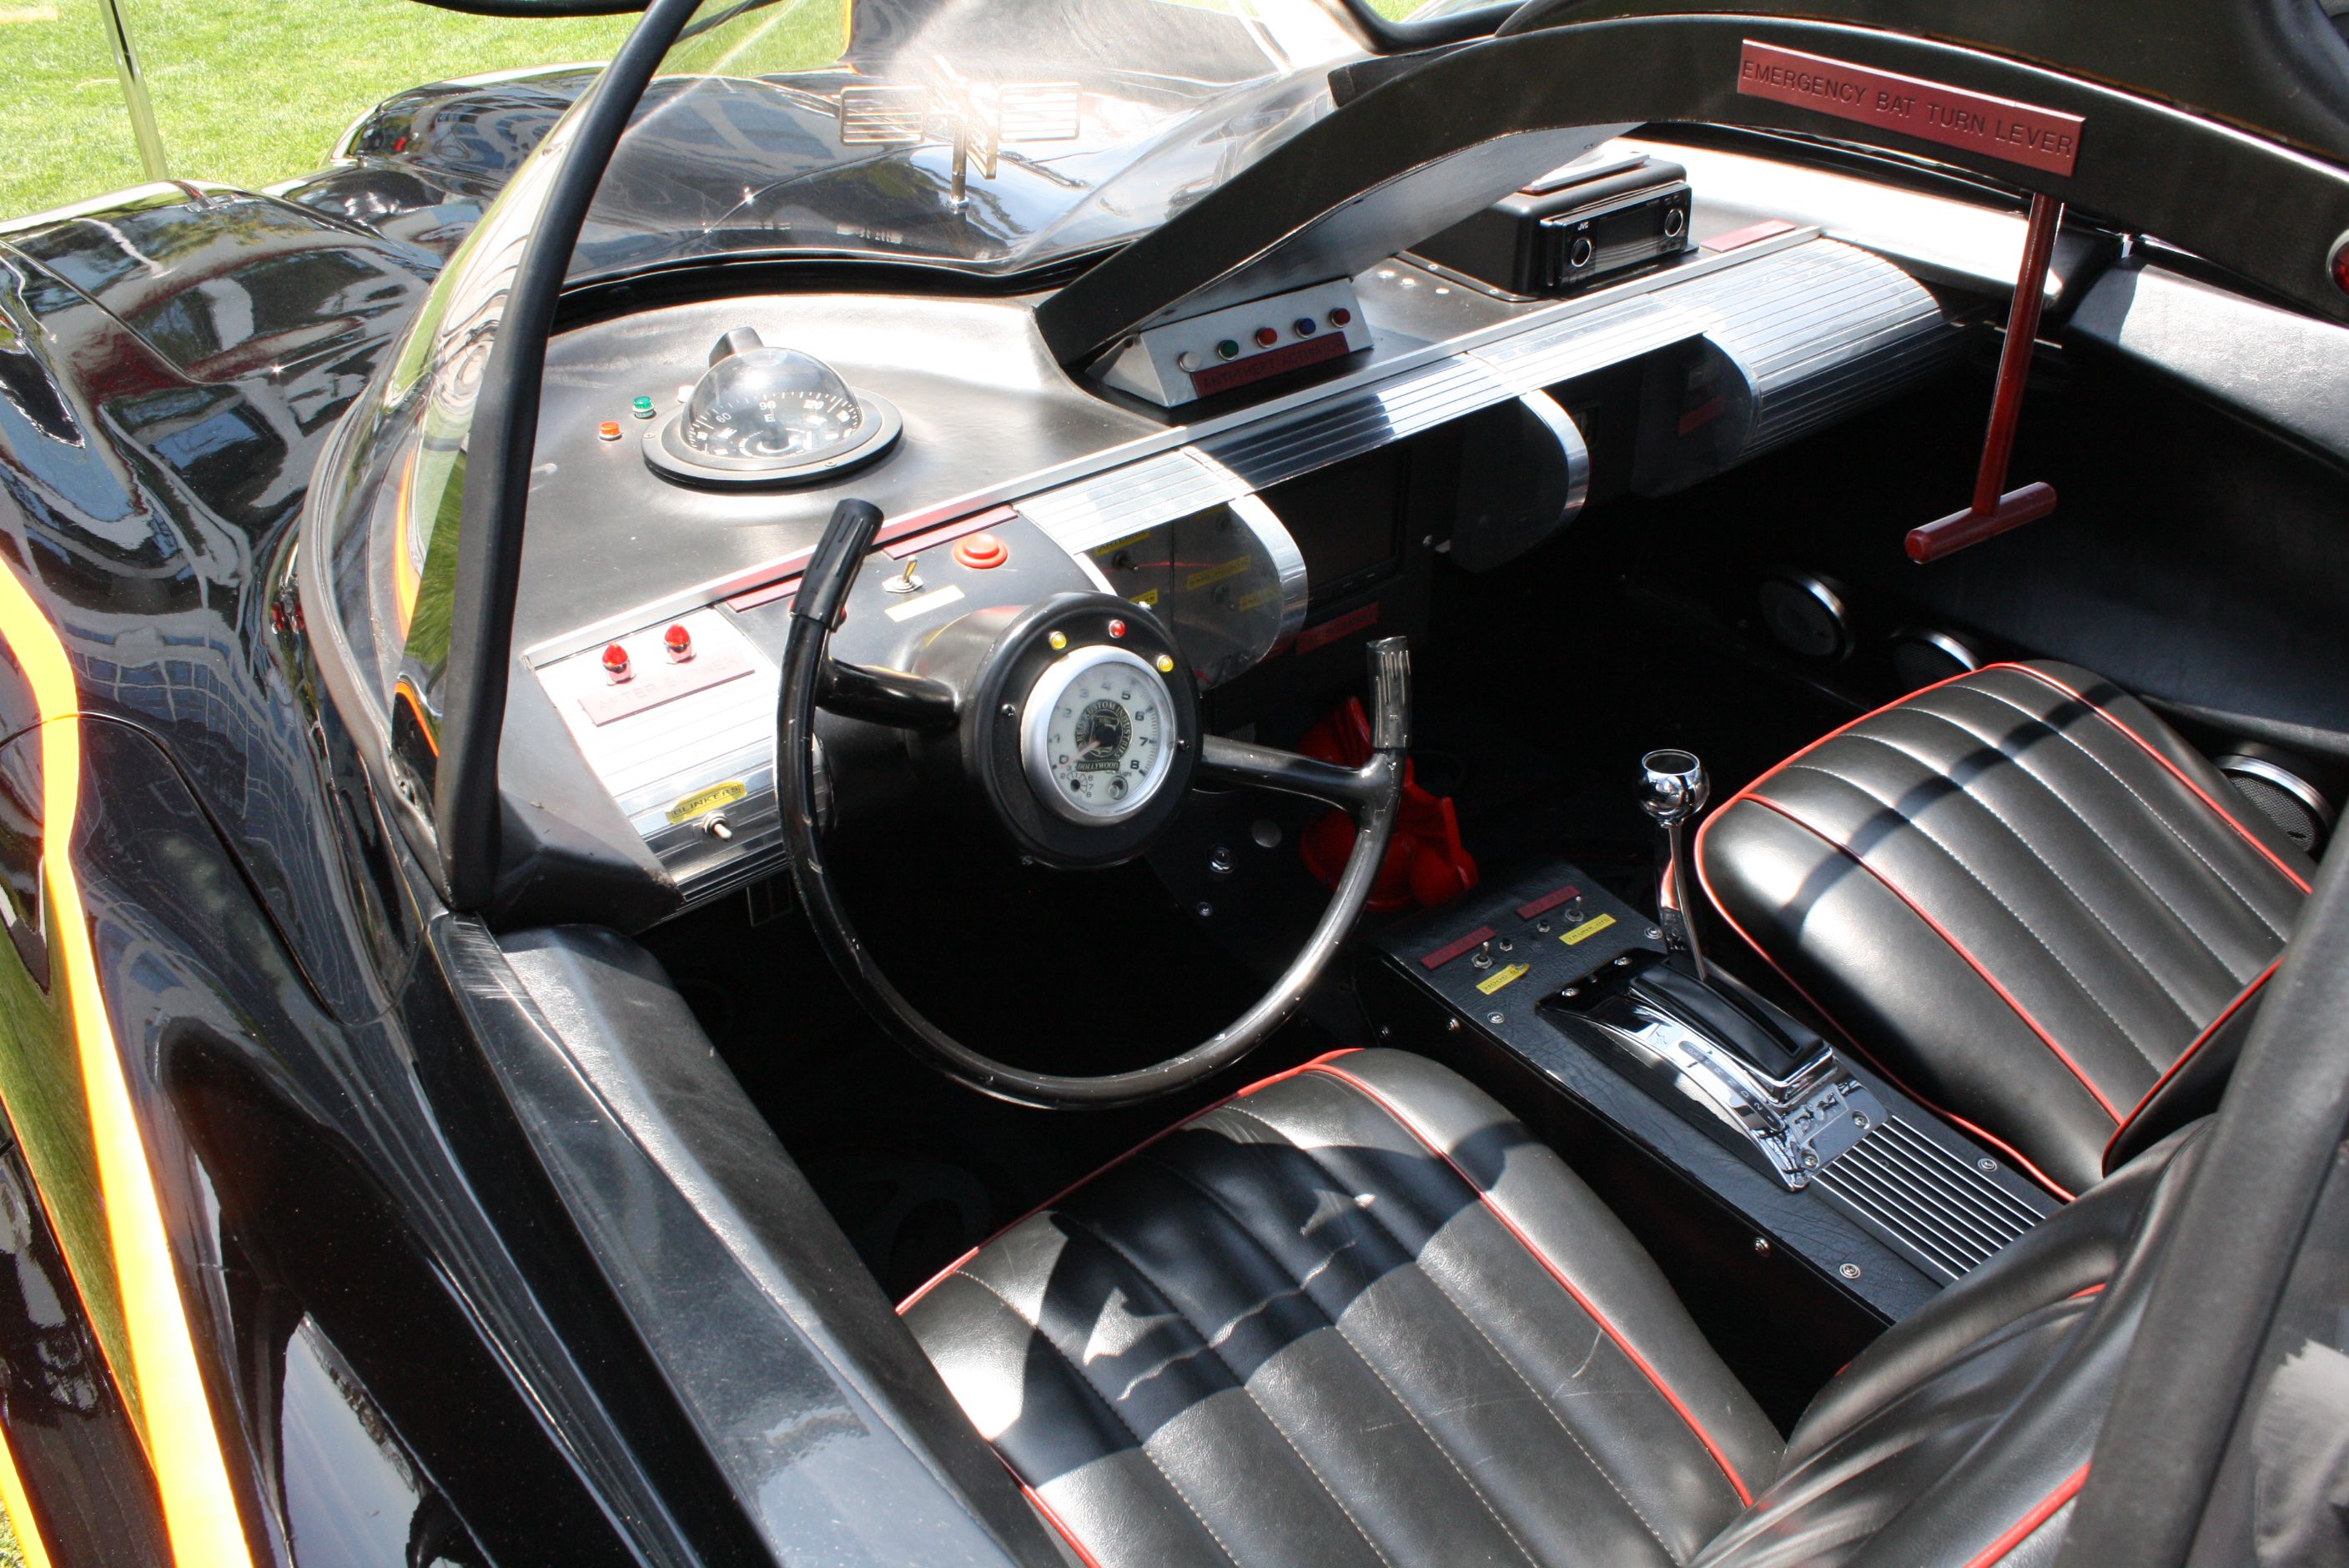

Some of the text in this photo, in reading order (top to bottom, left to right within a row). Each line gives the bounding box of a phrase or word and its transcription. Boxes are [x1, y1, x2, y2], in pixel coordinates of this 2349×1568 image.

[1742, 60, 2074, 158] EMERGENCY BAT TURN LEVER
[1577, 221, 1589, 231] JVC
[1281, 339, 1346, 365] ACTIVATOR
[715, 412, 732, 424] 60
[598, 683, 660, 711] AFTER
[1121, 691, 1131, 701] 5
[1135, 711, 1145, 721] 6
[1139, 736, 1149, 746] 7
[1077, 761, 1119, 771] HOLLYWOOD
[1130, 759, 1140, 770] 8
[672, 786, 741, 817] BLINKERS
[1740, 1090, 1749, 1098] D
[1753, 1102, 1763, 1111] 2
